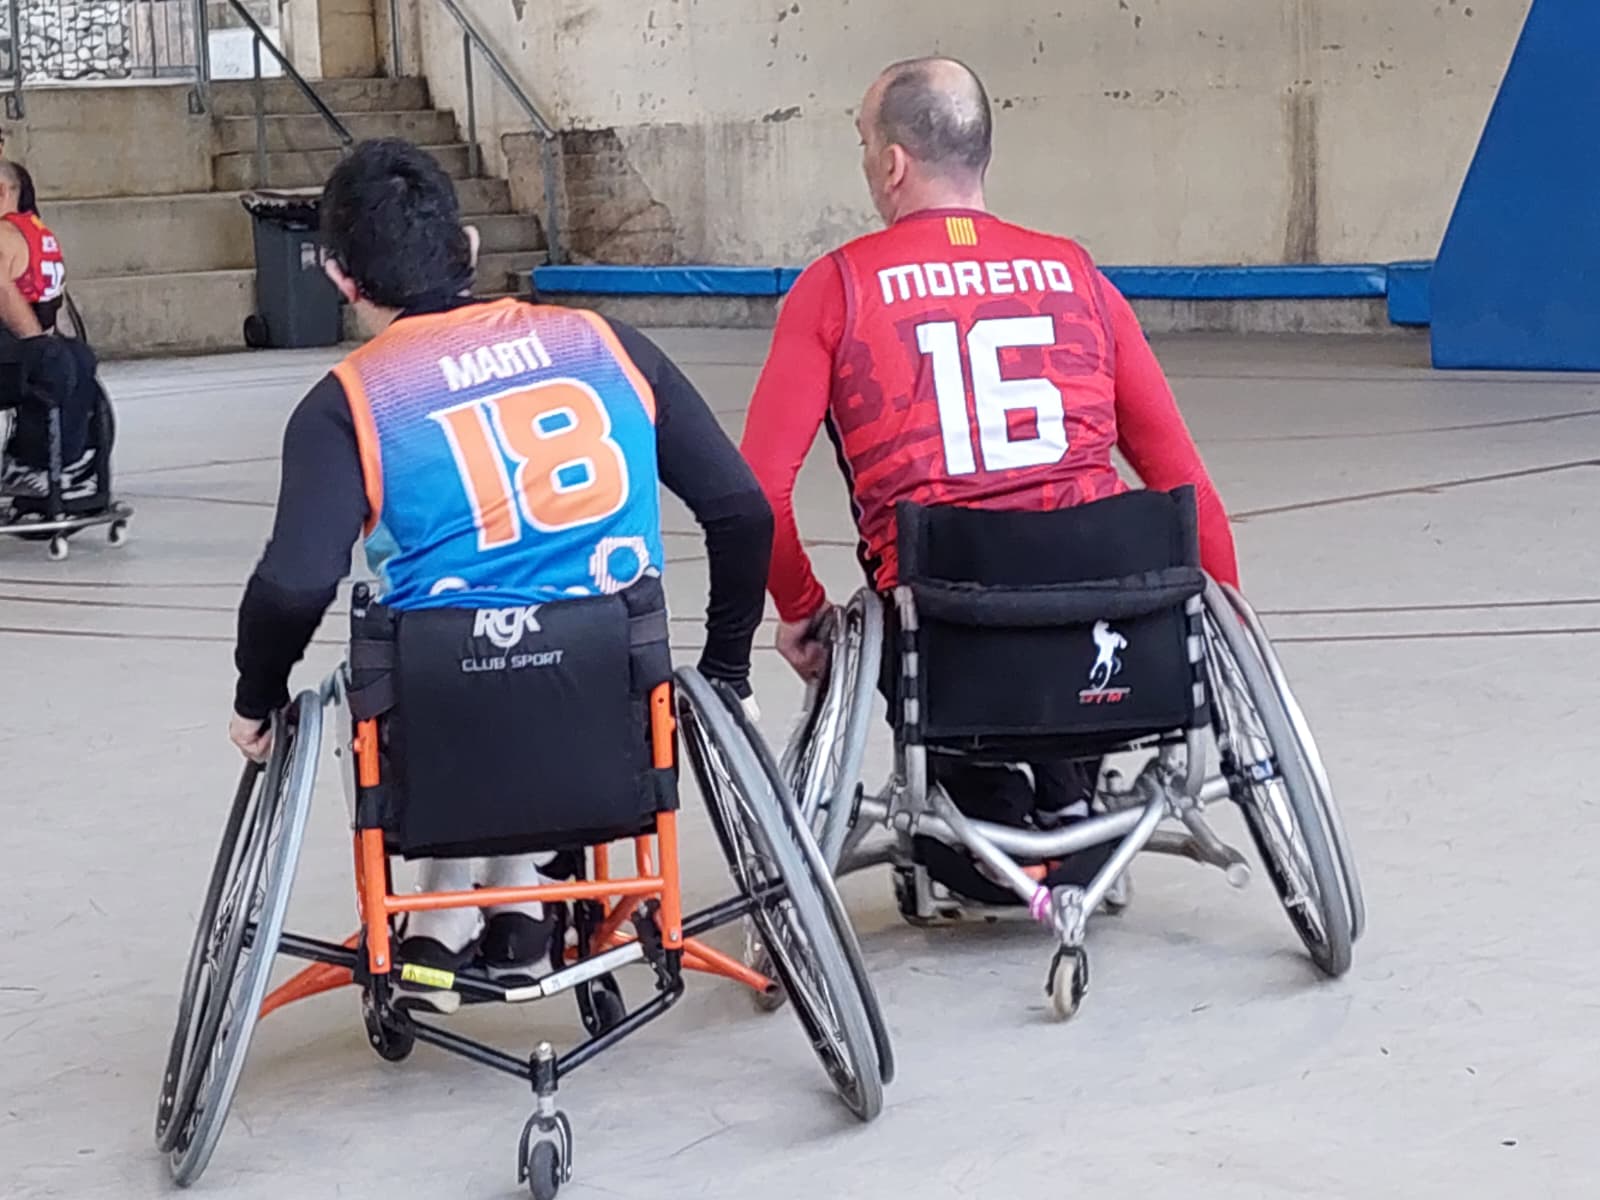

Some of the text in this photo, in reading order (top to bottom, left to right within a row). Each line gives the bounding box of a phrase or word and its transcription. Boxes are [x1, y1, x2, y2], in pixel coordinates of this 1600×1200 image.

[877, 258, 1074, 304] MORENO
[914, 315, 1070, 476] 16
[425, 377, 630, 553] 18
[461, 650, 564, 672] CLUB SPORT
